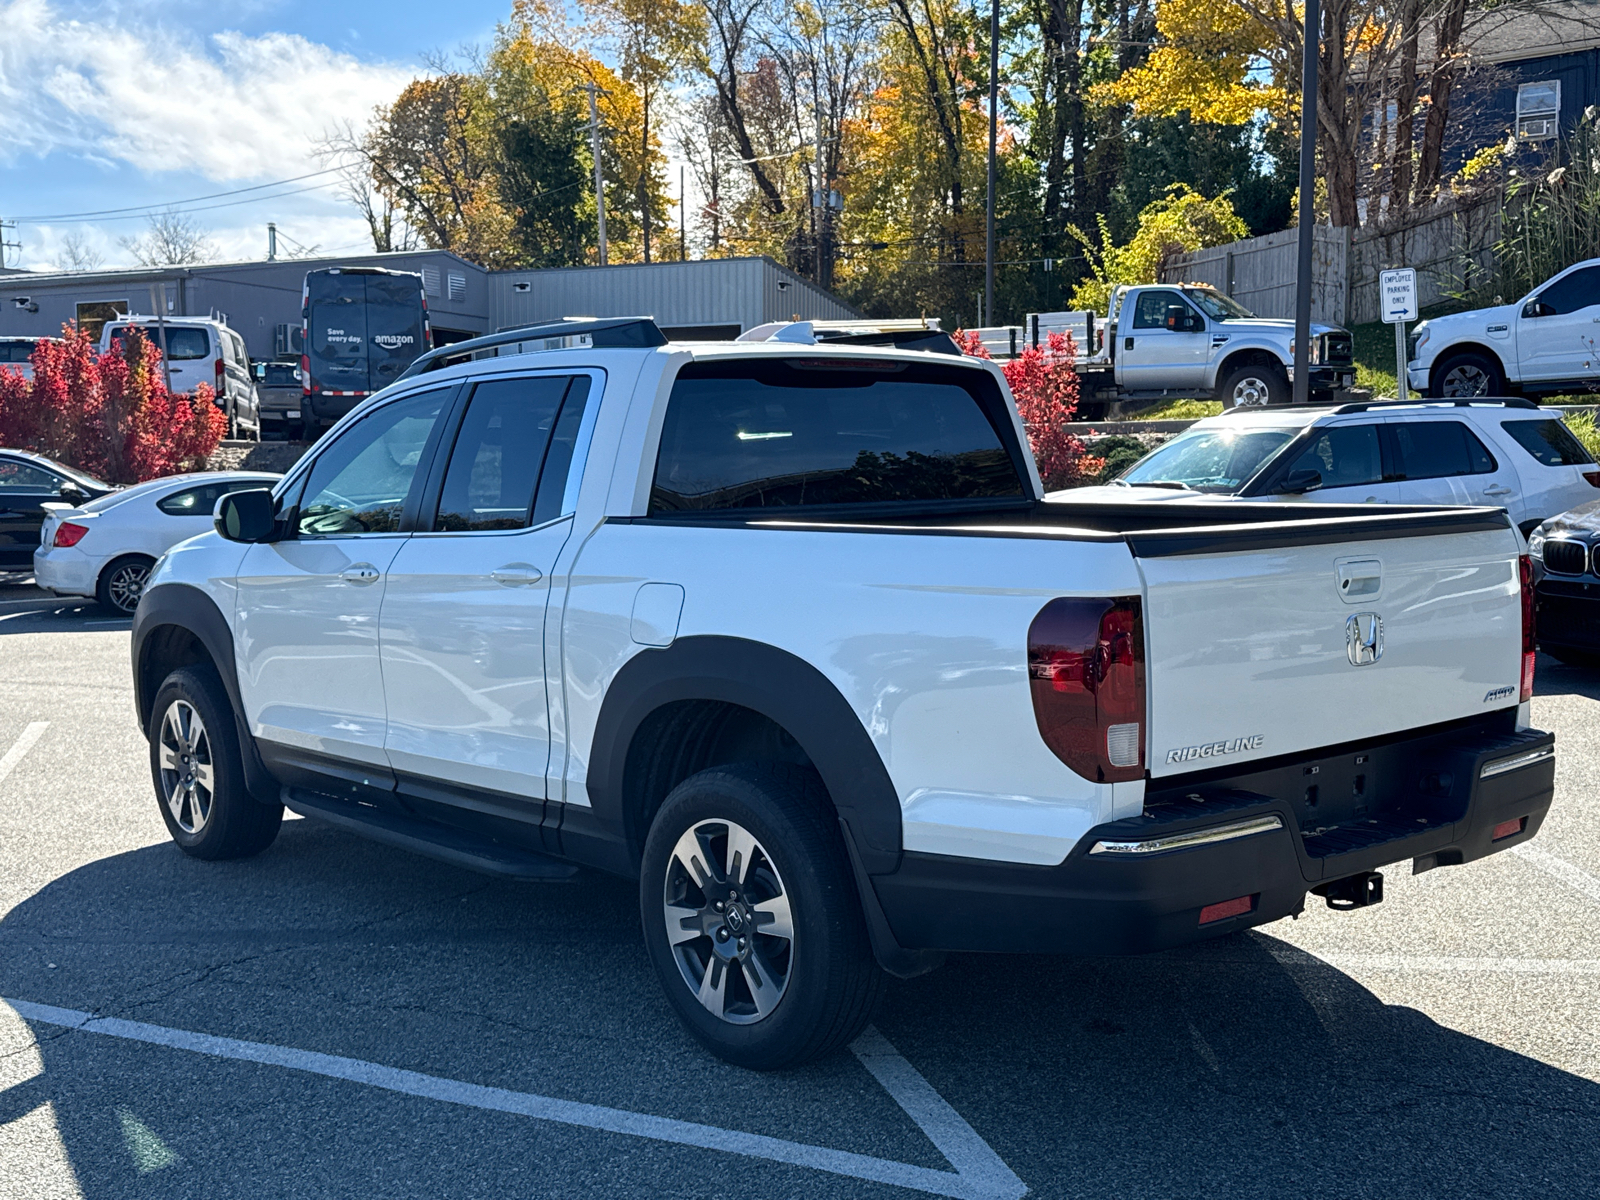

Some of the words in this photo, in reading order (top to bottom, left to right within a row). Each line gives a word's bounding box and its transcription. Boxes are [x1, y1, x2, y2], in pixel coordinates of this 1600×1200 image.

[1384, 274, 1412, 284] EMPLOYEE
[1387, 285, 1410, 294] PARKING
[1392, 296, 1406, 304] ONLY
[348, 336, 362, 344] day.
[374, 335, 414, 344] amazon
[1165, 734, 1264, 765] RIDGELINE
